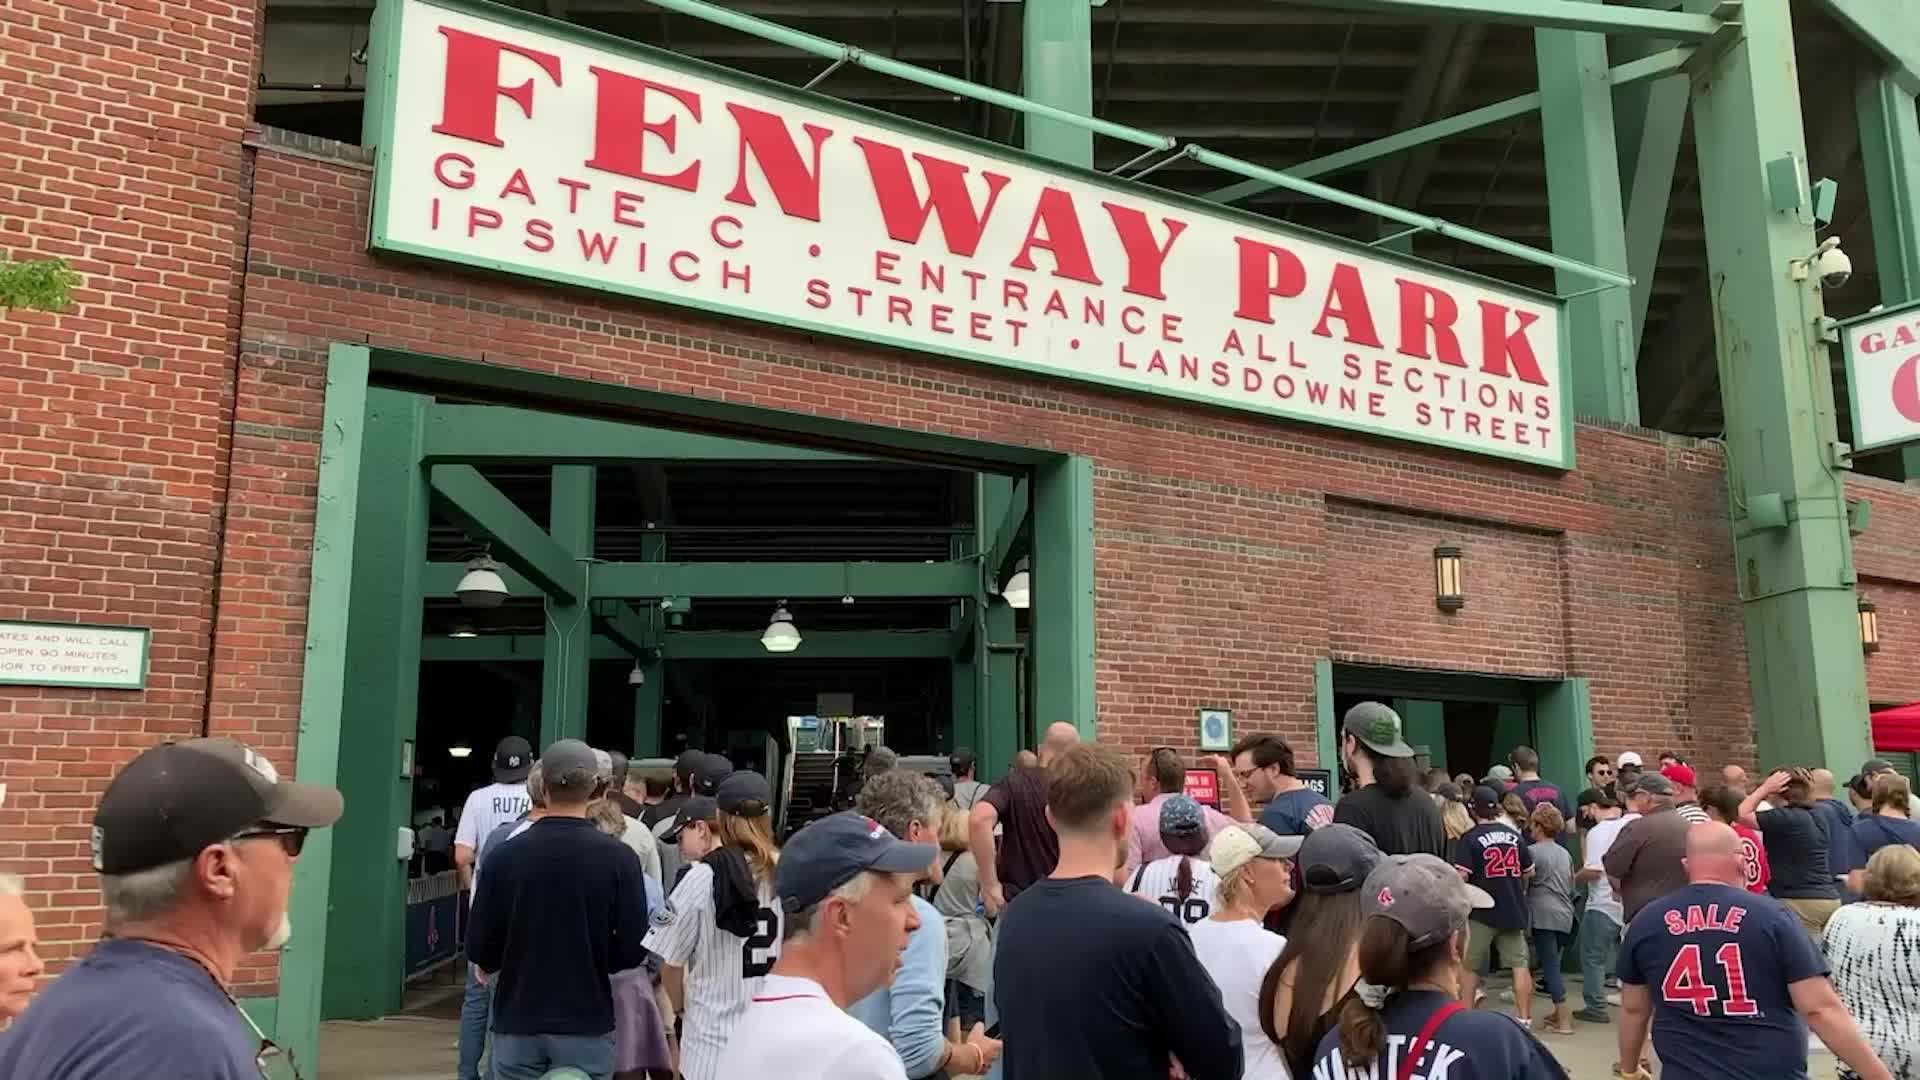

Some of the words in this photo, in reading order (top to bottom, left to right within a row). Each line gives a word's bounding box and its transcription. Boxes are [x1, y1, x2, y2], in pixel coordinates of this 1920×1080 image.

[431, 24, 1188, 301] FENWAY
[1232, 235, 1548, 387] PARK
[432, 152, 646, 229] GATE
[709, 213, 745, 250] C
[874, 249, 1184, 344] ENTRANCE
[1221, 328, 1308, 370] ALL
[1342, 352, 1552, 421] SECTIONS
[430, 197, 752, 294] IPSWICH
[806, 278, 1027, 348] STREET
[1117, 341, 1387, 418] LANSDOWNE
[1416, 401, 1552, 450] STREET
[1860, 320, 1920, 354] GA
[0, 632, 29, 642] ATES
[35, 634, 61, 644] AND
[66, 637, 92, 646] WILL
[100, 637, 129, 648] CALL
[0, 647, 34, 657] OPEN
[40, 648, 59, 658] 90
[65, 650, 119, 661] MINUTES
[0, 662, 24, 672] IOR
[31, 663, 46, 673] TO
[51, 664, 88, 674] FIRST
[93, 666, 129, 676] PITCH
[492, 796, 530, 815] RUTH
[1482, 846, 1521, 879] 24
[1663, 904, 1748, 936] SALE
[1661, 943, 1759, 1016] 41
